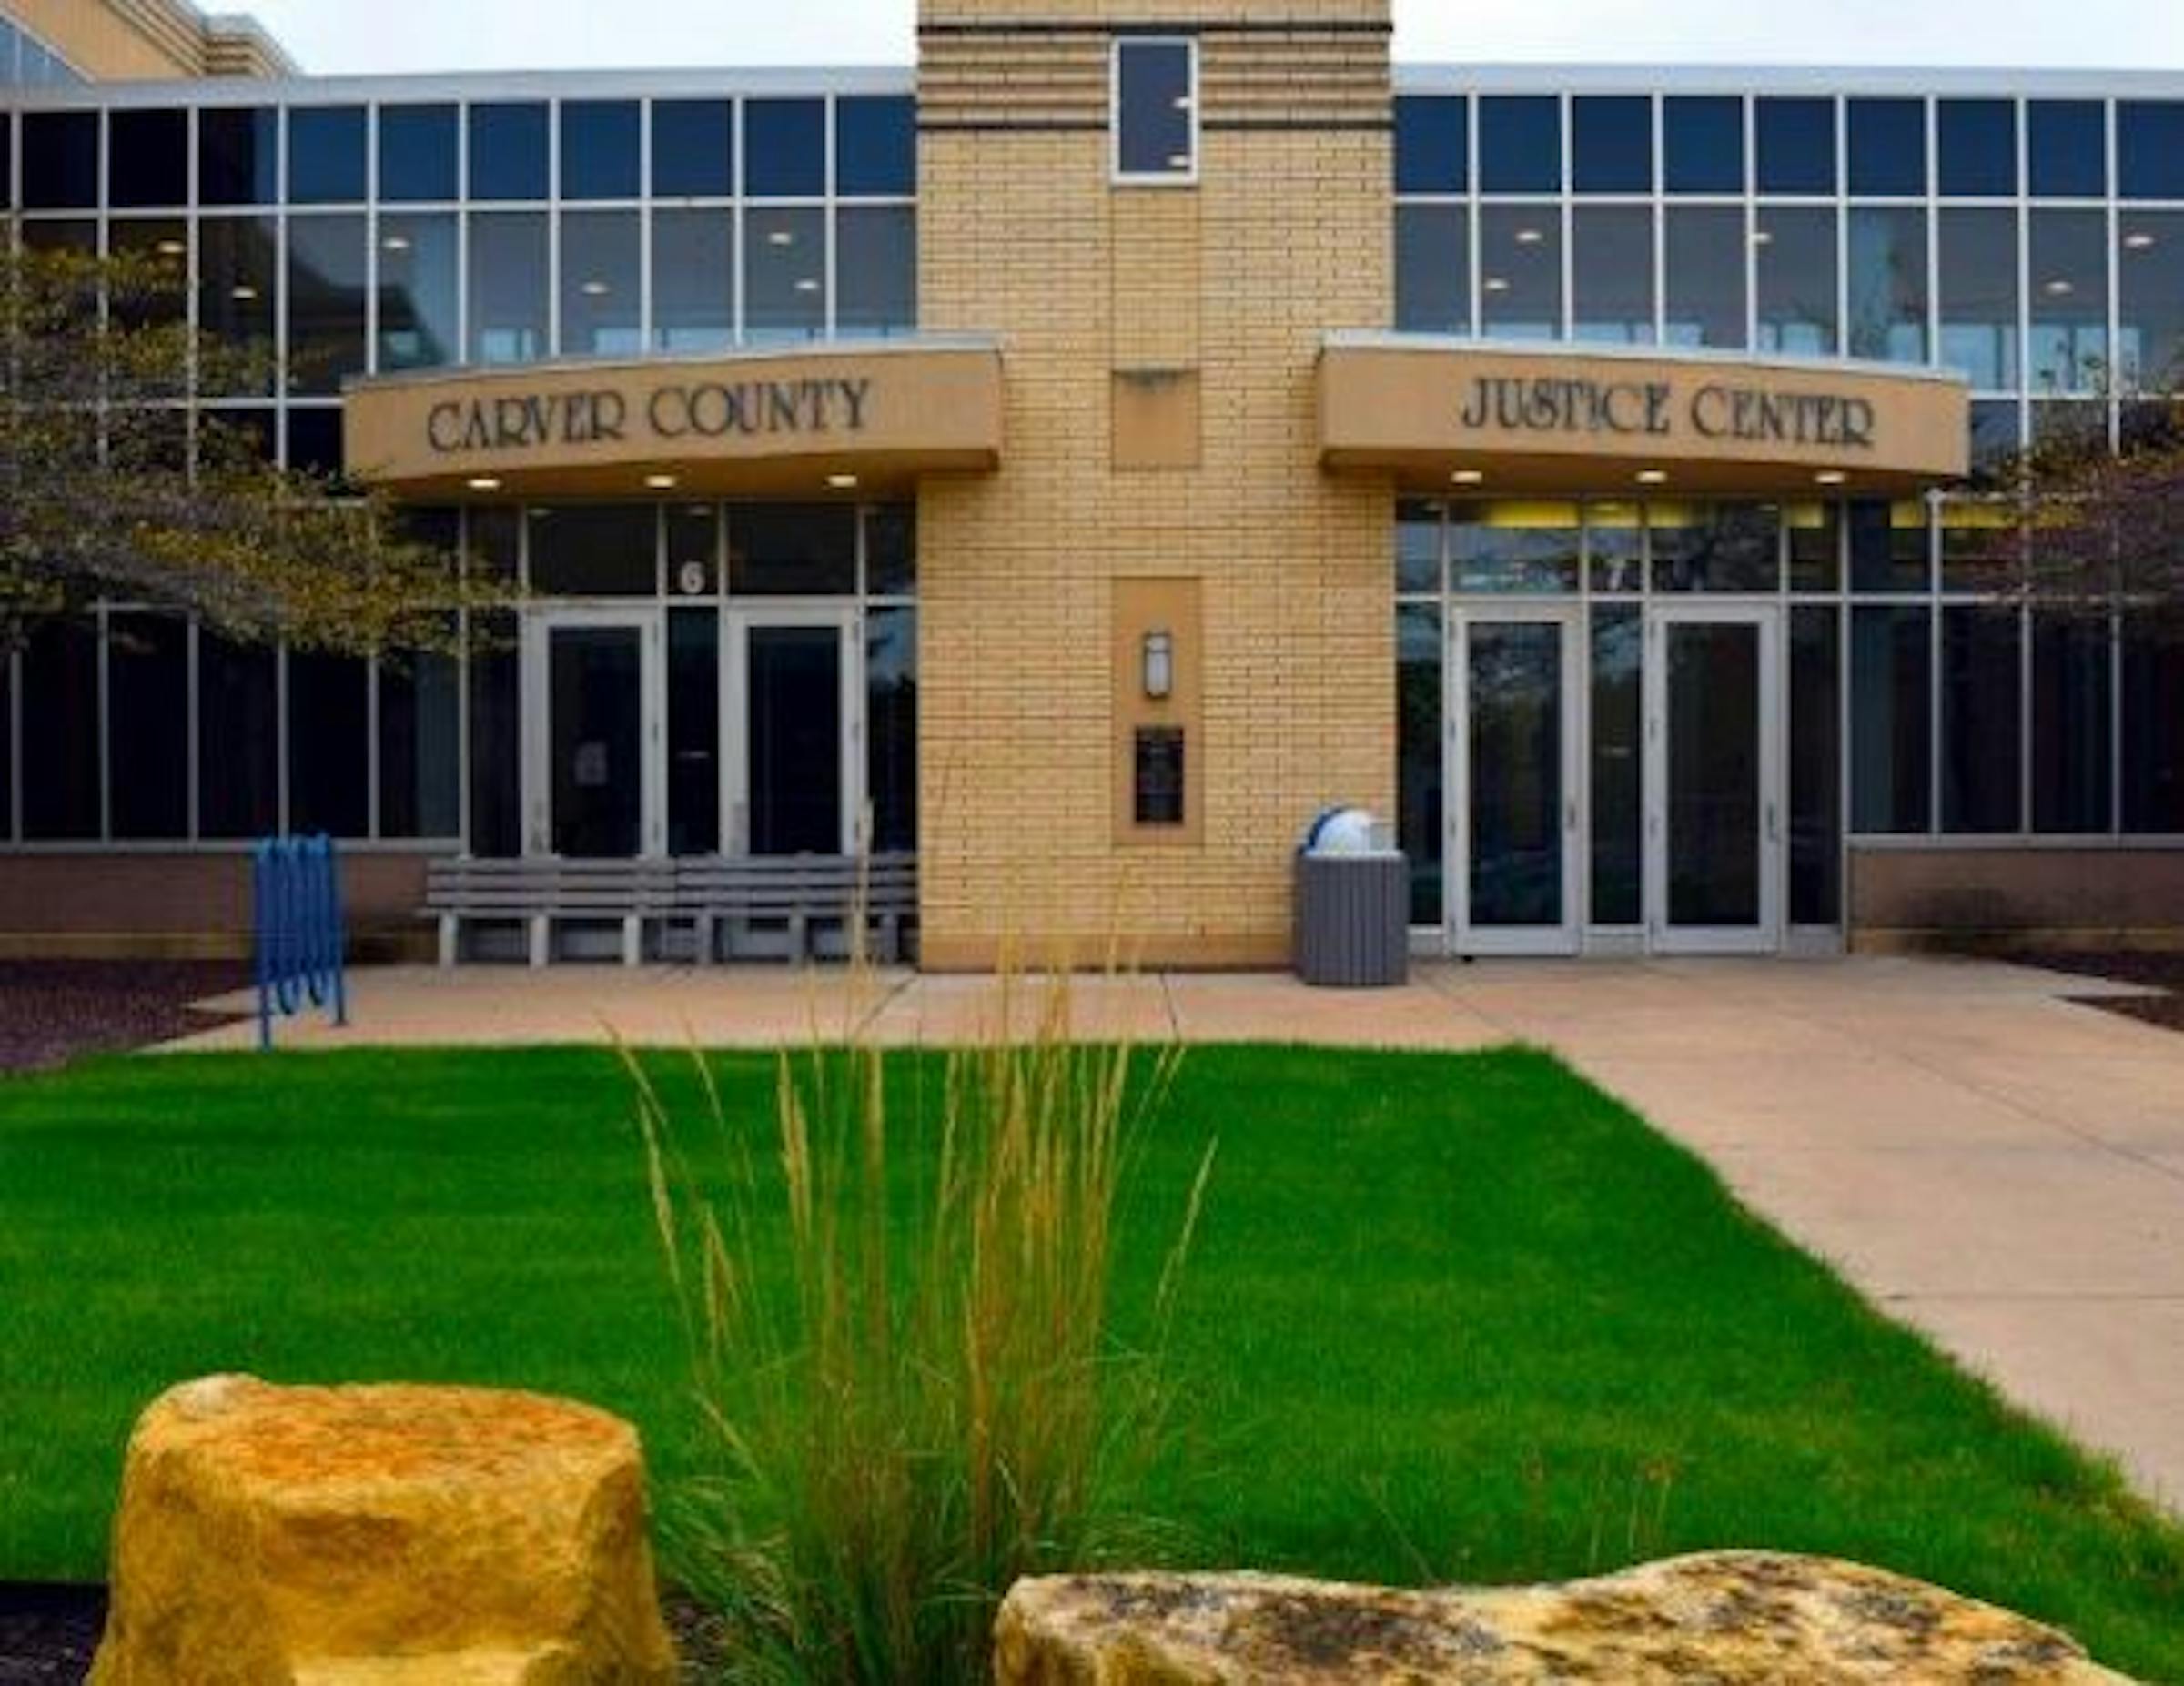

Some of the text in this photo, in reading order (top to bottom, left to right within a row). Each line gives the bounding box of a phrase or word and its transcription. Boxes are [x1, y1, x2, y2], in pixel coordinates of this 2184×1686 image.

[427, 378, 871, 453] CARVER COUNTY
[1462, 377, 1875, 447] JUSTICE CENTER
[680, 560, 705, 594] 6
[1603, 558, 1627, 591] 7
